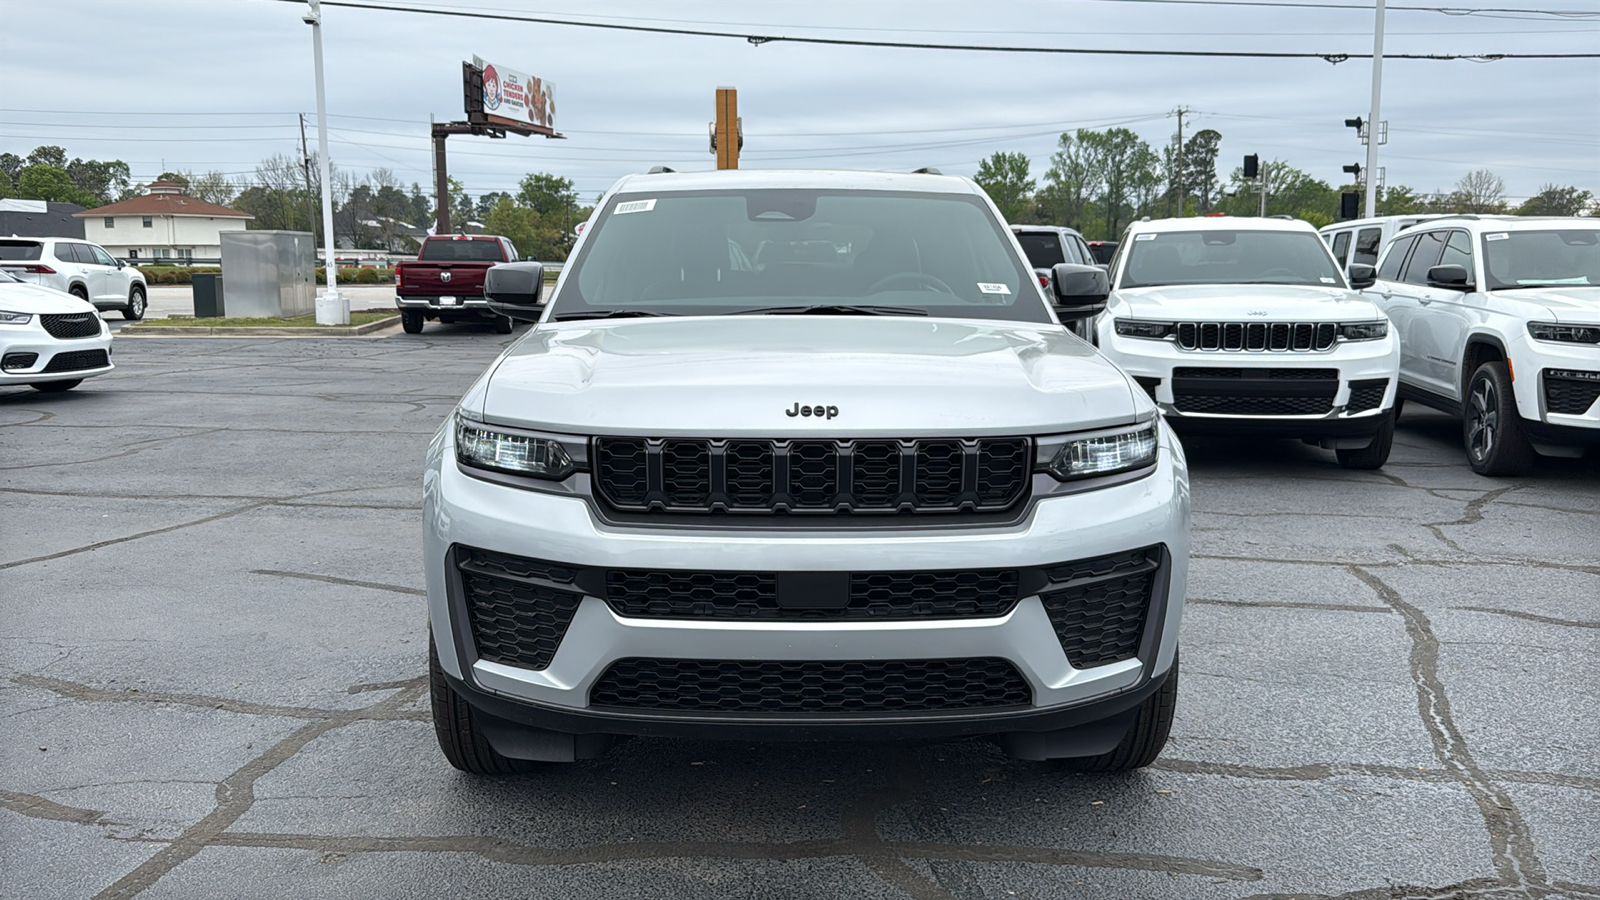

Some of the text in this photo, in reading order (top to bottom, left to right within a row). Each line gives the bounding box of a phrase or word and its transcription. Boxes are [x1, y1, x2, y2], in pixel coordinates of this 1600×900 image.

[503, 80, 523, 92] CHICKEN
[503, 89, 523, 101] TENDERS
[785, 402, 839, 420] Jeep
